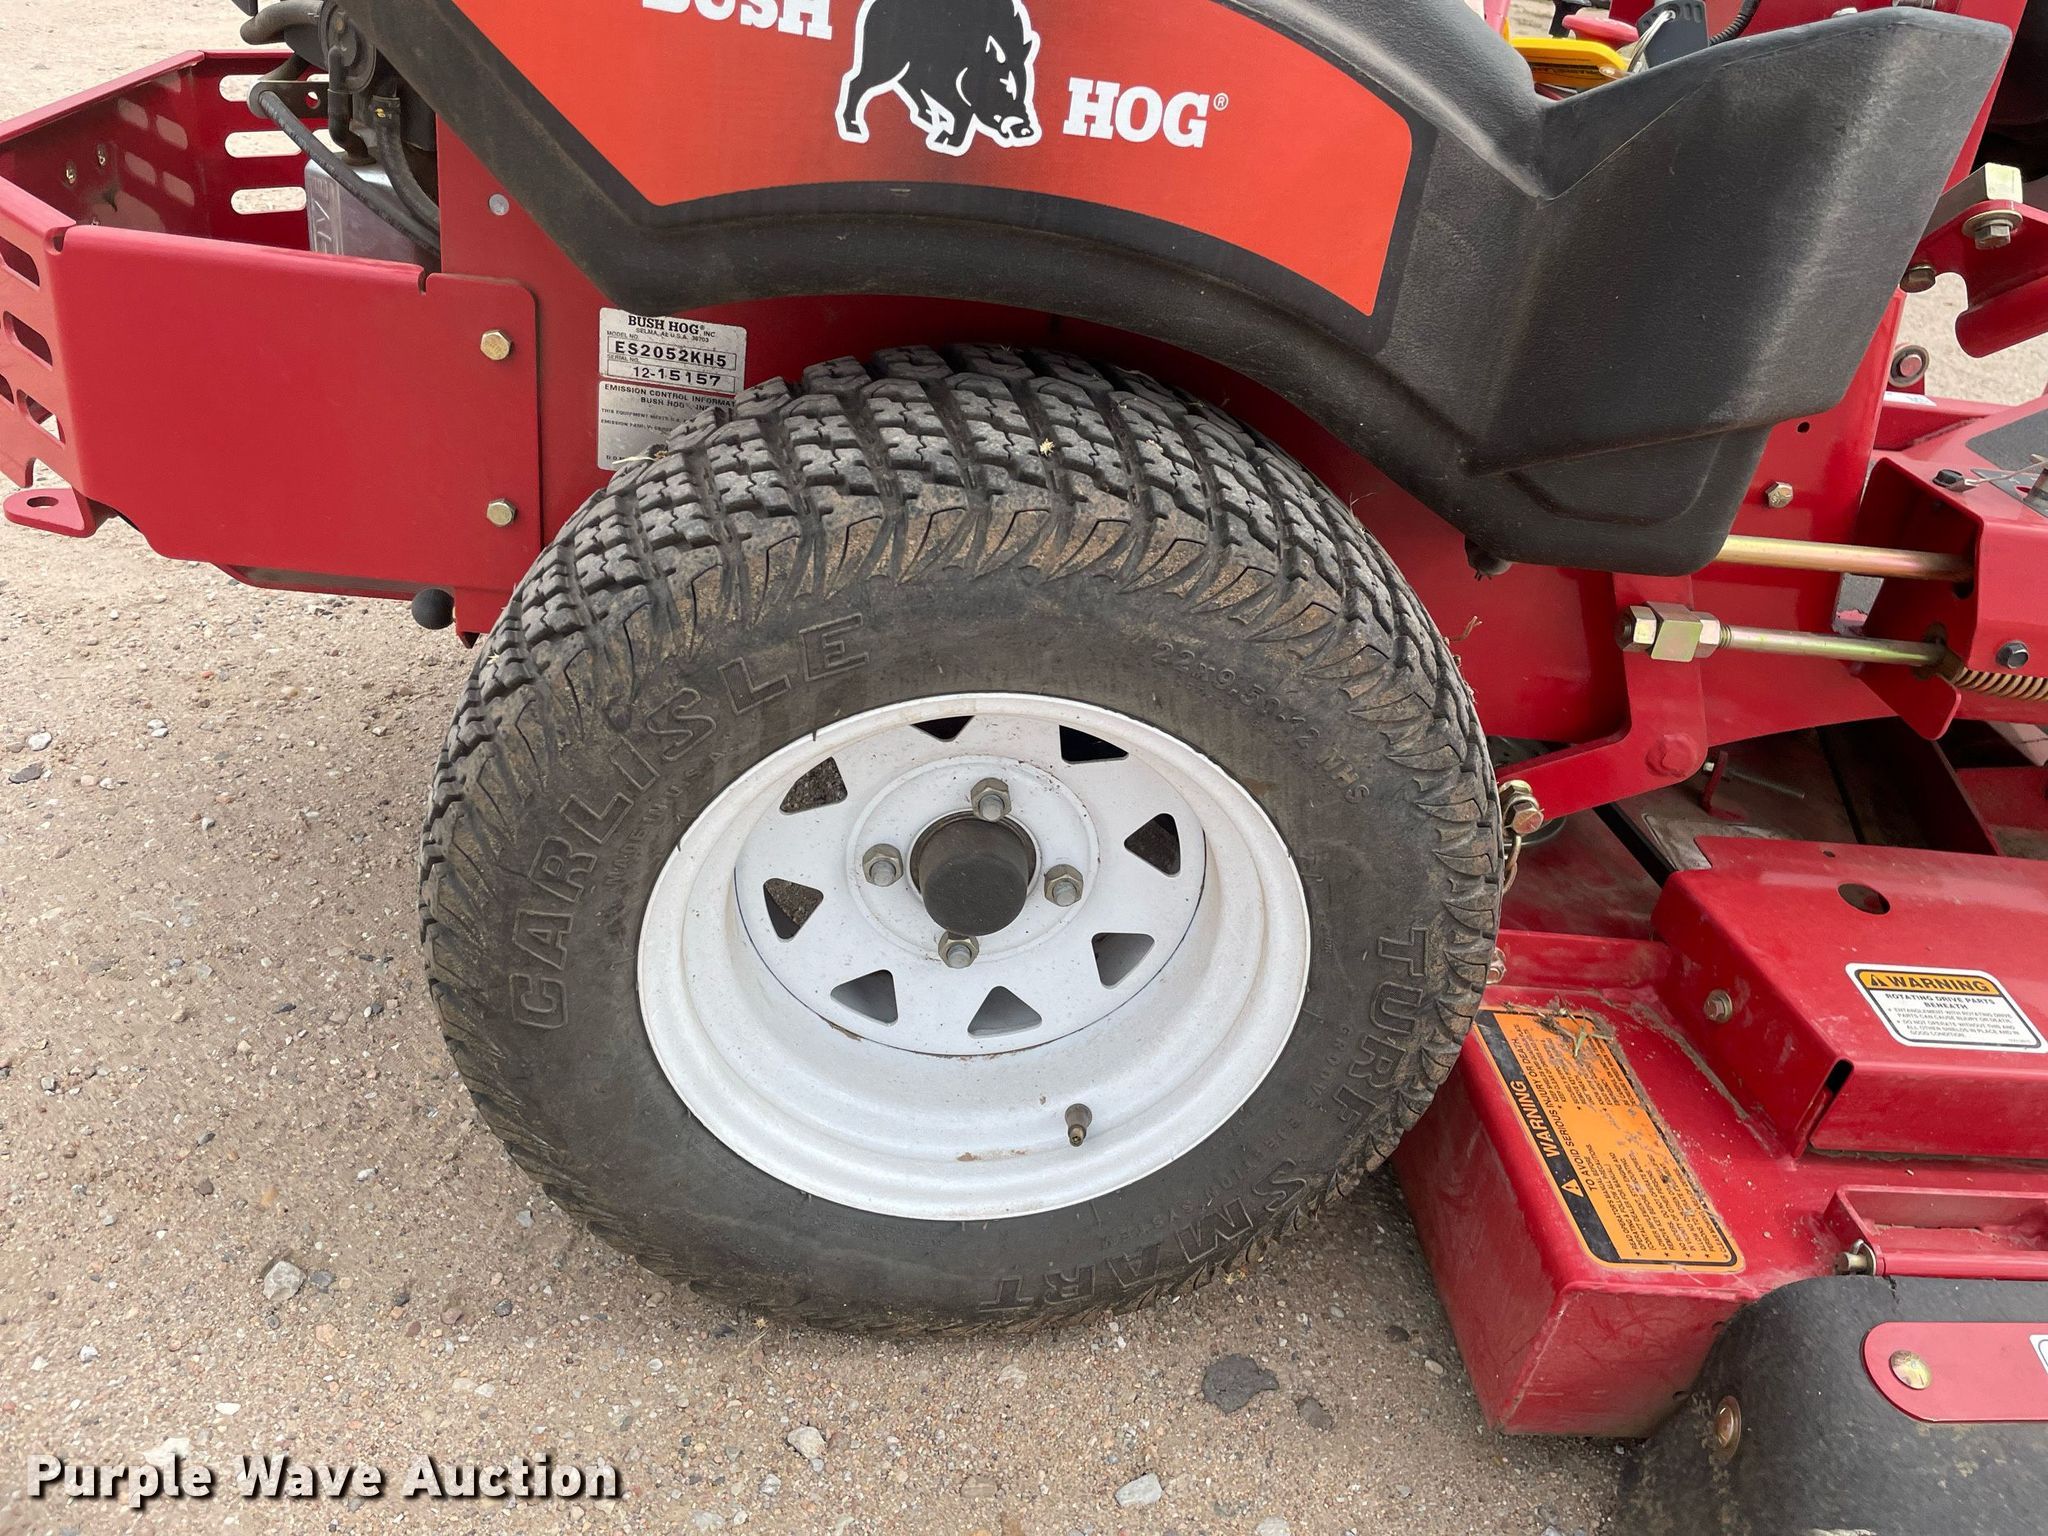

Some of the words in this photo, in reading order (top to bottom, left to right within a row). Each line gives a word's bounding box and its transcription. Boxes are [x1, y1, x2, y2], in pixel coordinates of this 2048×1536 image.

[628, 316, 664, 330] BUSH
[615, 341, 727, 367] ES2052KH5
[633, 367, 721, 387] 12-15157
[605, 384, 646, 395] EMISSION
[649, 390, 688, 401] CONTROL
[641, 397, 664, 405] BUSH
[511, 612, 870, 1030] CARLISLE
[1886, 976, 1990, 992] WARNING
[1885, 993, 1933, 1001] ROTATING
[1333, 927, 1430, 1124] TURF
[1525, 1066, 1536, 1076] OR
[1534, 1080, 1553, 1107] INJURY
[1510, 1080, 1560, 1158] WARNING
[1549, 1110, 1574, 1146] SERIOUS
[1570, 1150, 1589, 1176] AVOID
[1583, 1157, 1598, 1176] BEFORE
[1608, 1153, 1618, 1162] AND
[1615, 1164, 1629, 1182] ENGINE
[1585, 1180, 1597, 1190] TO
[1595, 1178, 1610, 1198] MANUAL
[1605, 1181, 1613, 1189] ALL
[1617, 1190, 1627, 1199] FOR
[1626, 1184, 1637, 1197] STOP
[1639, 1174, 1657, 1197] OPERATE
[1610, 1191, 1626, 1212] FOLLOW
[1623, 1201, 1639, 1221] DEALER
[1639, 1194, 1655, 1214] BEFORE
[1653, 1199, 1663, 1208] NOT
[1651, 1216, 1661, 1226] KEY
[979, 1157, 1308, 1313] SMART
[1625, 1235, 1637, 1249] READ
[1626, 1219, 1646, 1249] OPERATING
[1651, 1231, 1666, 1250] LOWER
[1658, 1228, 1674, 1250] REMOVE
